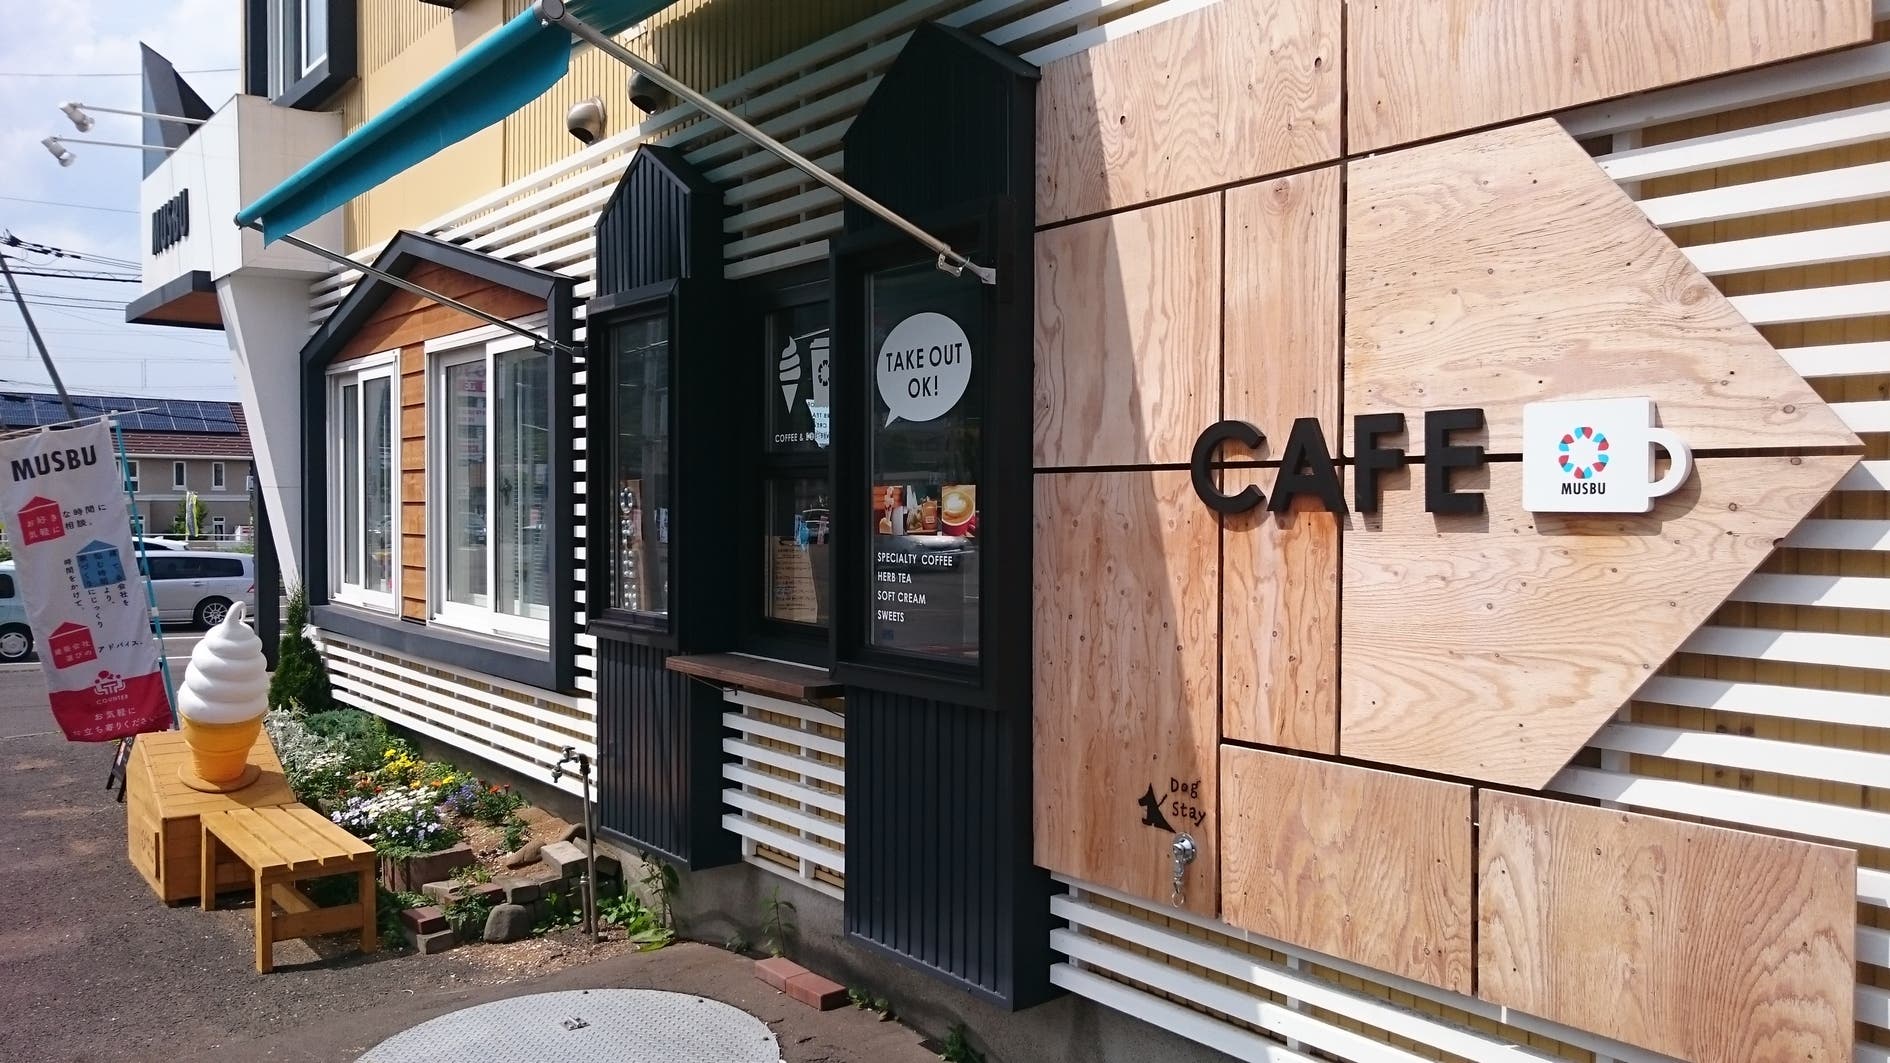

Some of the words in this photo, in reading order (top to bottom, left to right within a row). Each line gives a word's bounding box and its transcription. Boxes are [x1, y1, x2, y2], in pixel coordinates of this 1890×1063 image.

[152, 188, 189, 256] MUSBU
[886, 348, 924, 372] TAKE
[929, 343, 962, 367] OUT
[908, 375, 938, 398] OK!
[774, 432, 798, 443] COFFEE
[10, 445, 97, 482] MUSBU
[1190, 408, 1485, 514] CAFE
[1561, 482, 1606, 495] MUSBU
[877, 551, 917, 564] SPECIALTY
[921, 554, 953, 567] COFFEE
[877, 571, 896, 583] HERB
[898, 573, 912, 584] TEA
[877, 590, 895, 602] SOFT
[897, 592, 926, 604] CREAM
[877, 609, 905, 622] SWEETS
[96, 694, 128, 705] COUNTER
[94, 707, 136, 721] お気軽に
[1170, 777, 1202, 799] Dog
[1172, 801, 1206, 827] Stay
